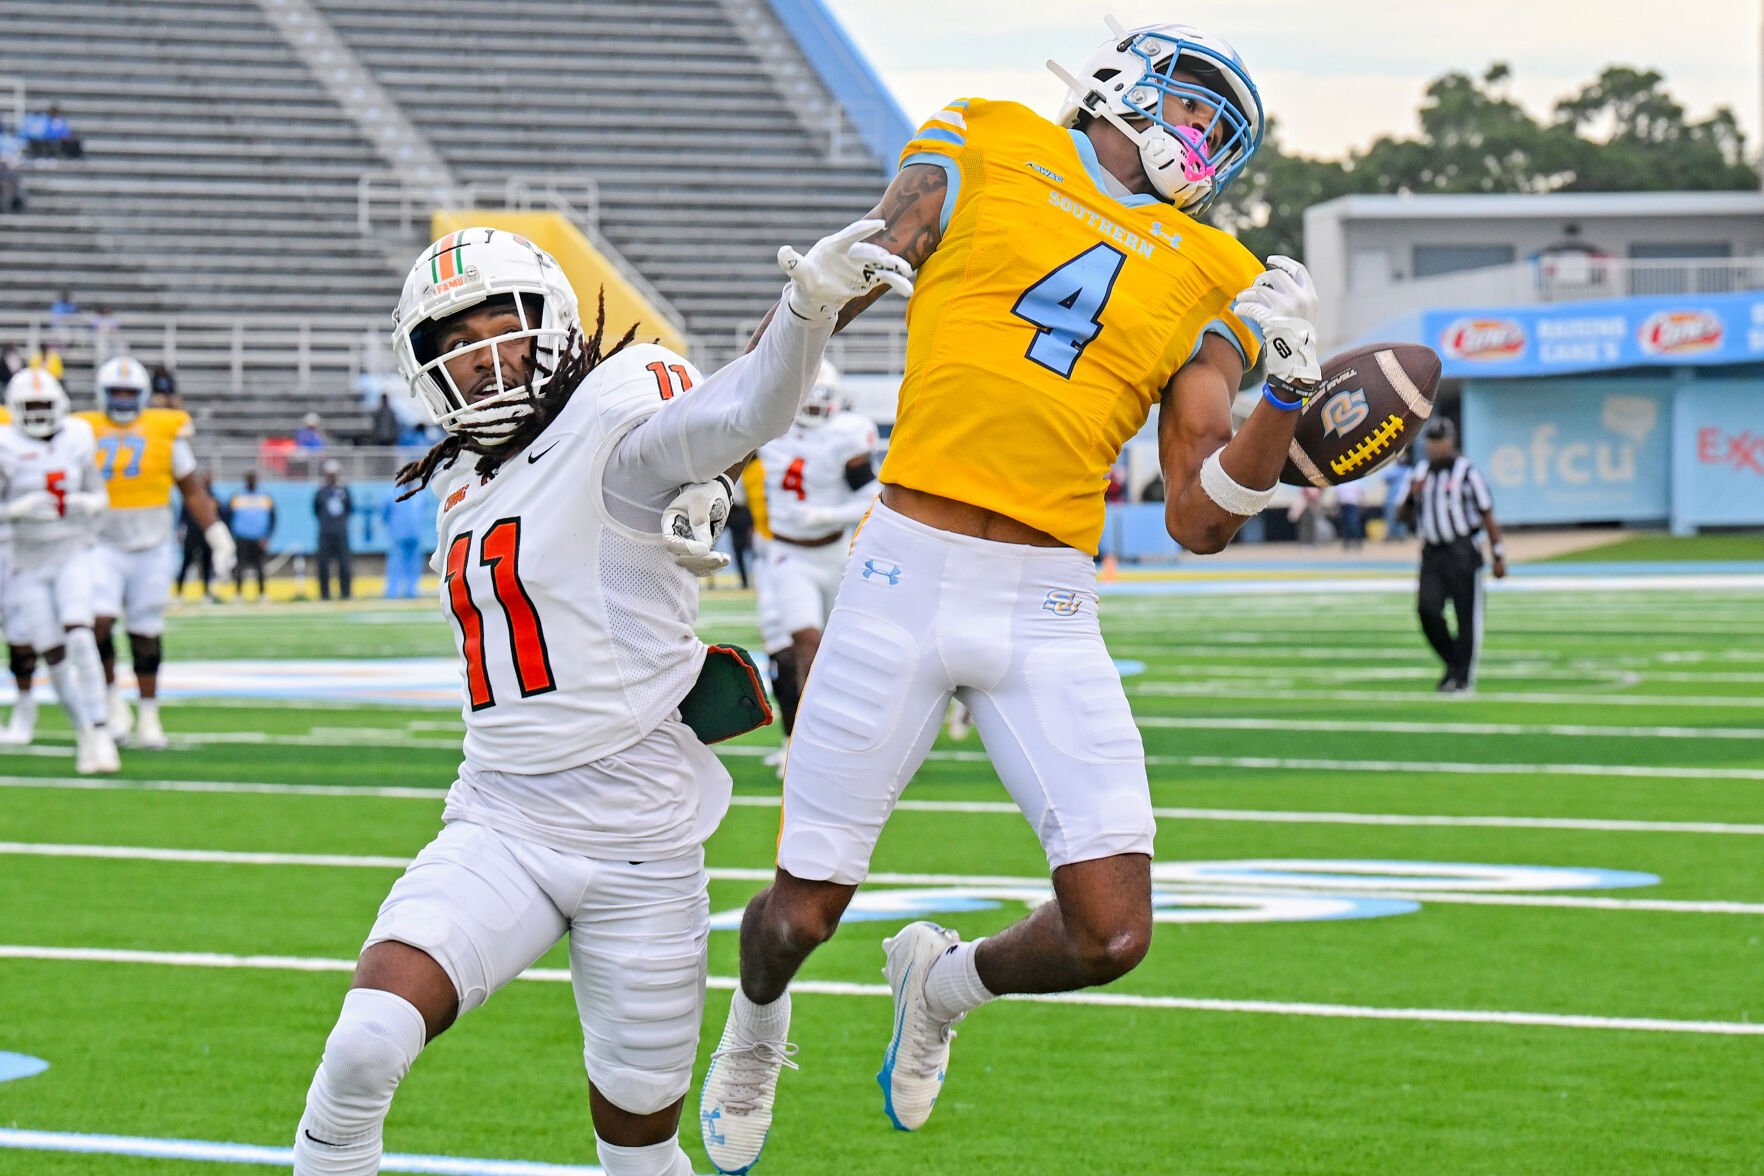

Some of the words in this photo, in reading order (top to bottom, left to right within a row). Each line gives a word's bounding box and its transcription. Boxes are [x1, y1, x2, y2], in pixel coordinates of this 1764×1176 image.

[1049, 191, 1155, 259] SOUTHERN
[436, 276, 465, 295] FAMU
[1010, 241, 1127, 380] 4
[645, 361, 693, 400] 11
[97, 436, 146, 481] 77
[782, 456, 806, 501] 4
[1491, 424, 1635, 487] efcu
[445, 516, 557, 712] 11
